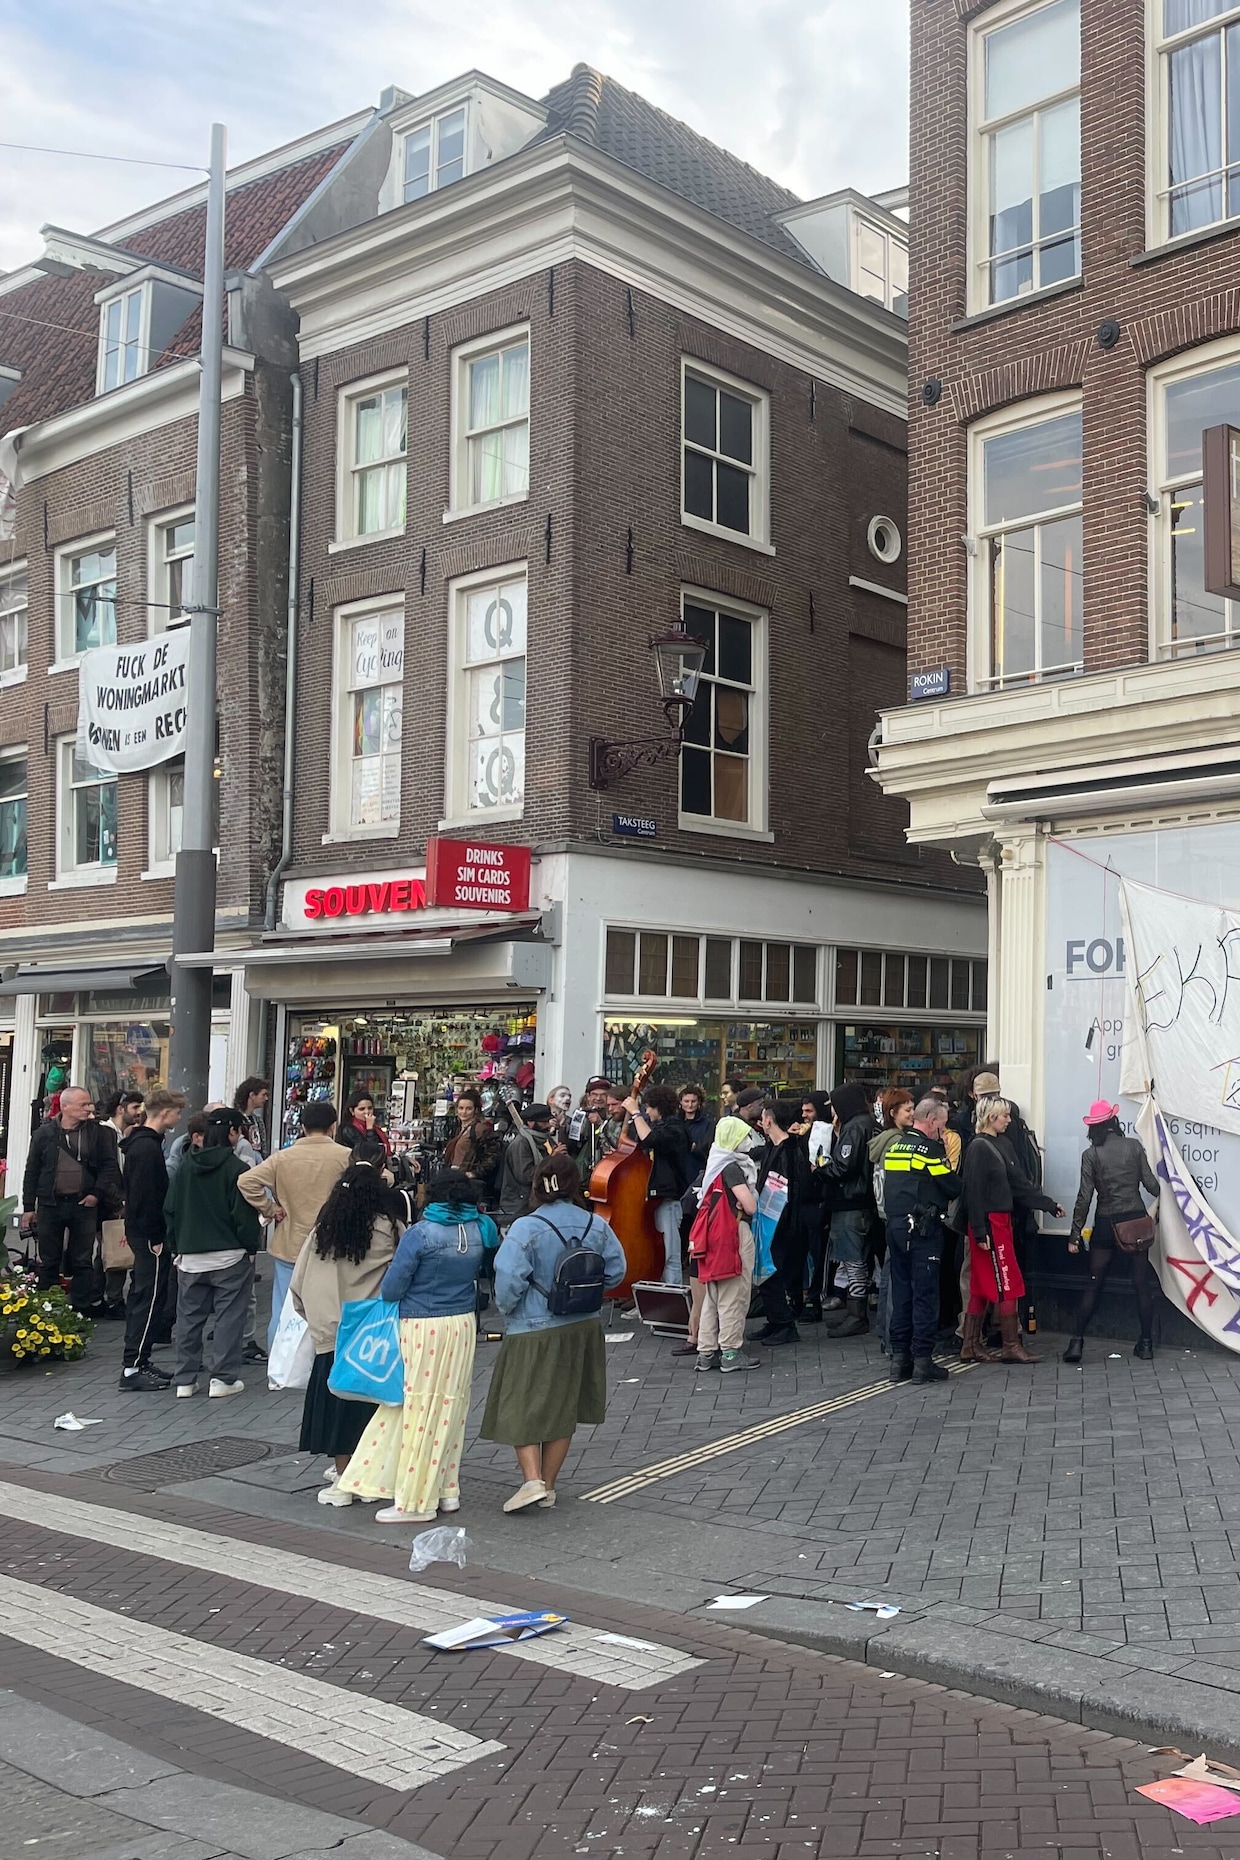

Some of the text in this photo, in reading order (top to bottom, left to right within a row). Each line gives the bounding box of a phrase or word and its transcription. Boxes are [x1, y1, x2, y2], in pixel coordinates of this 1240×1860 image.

[357, 627, 398, 648] Keep on
[116, 643, 169, 679] FUCK DE
[97, 663, 186, 711] WONINGMARKT
[914, 672, 943, 688] ROKIN
[618, 816, 656, 830] TAKSTEEG
[466, 848, 504, 867] DRINKS
[457, 866, 511, 886] SIM CARDS
[304, 879, 427, 919] SOUVEN
[455, 885, 511, 905] SOUVENIRS
[1181, 1144, 1220, 1162] floor
